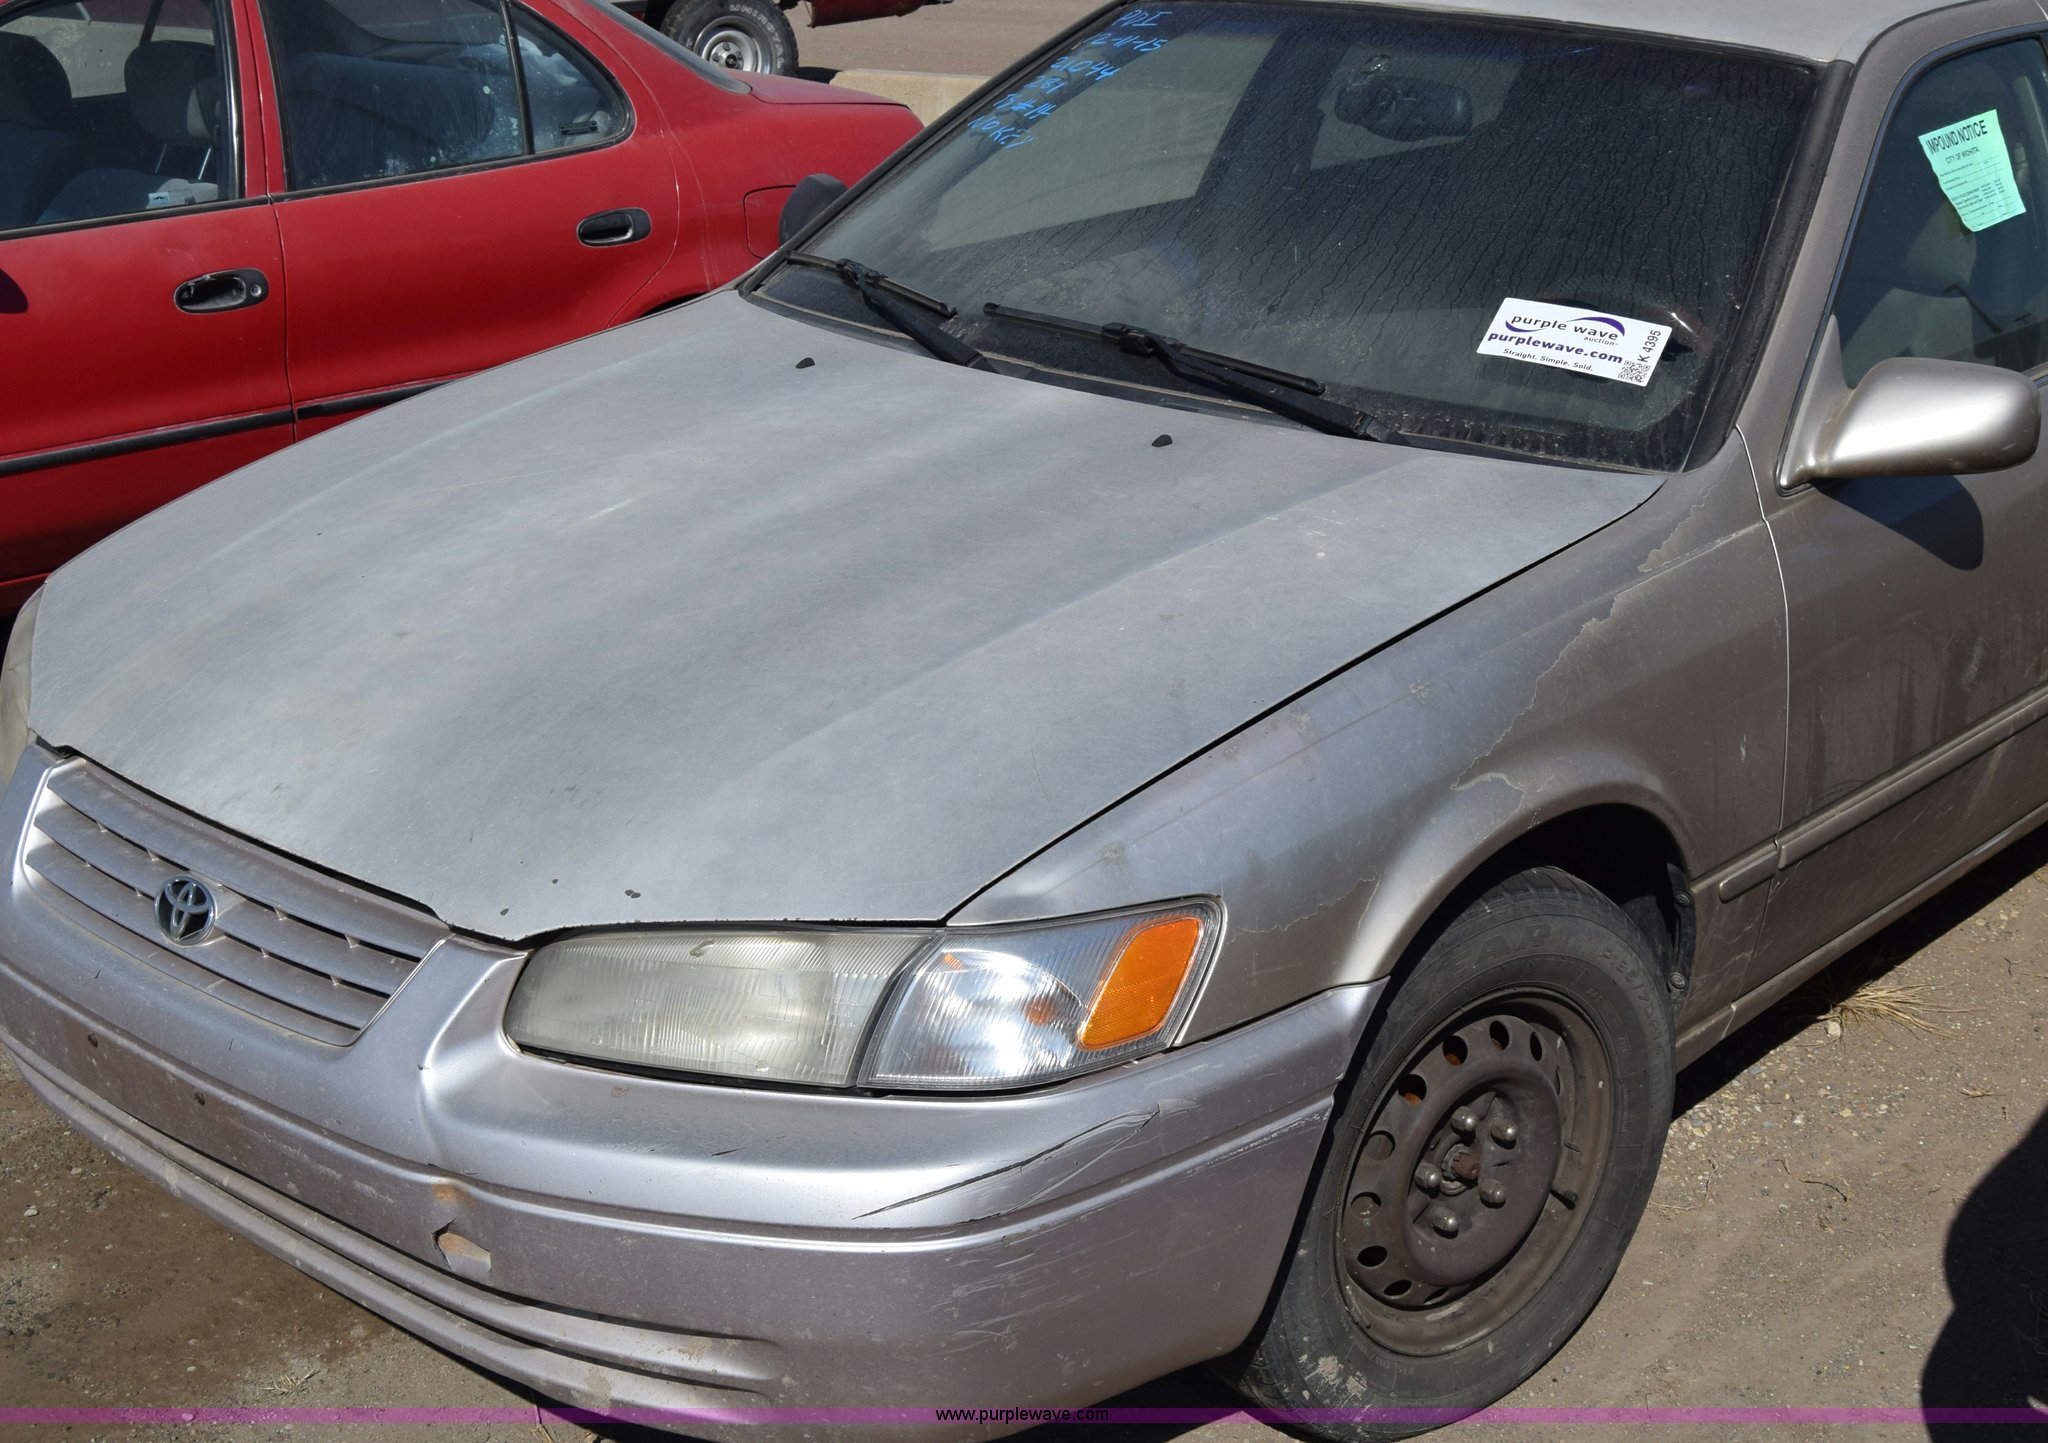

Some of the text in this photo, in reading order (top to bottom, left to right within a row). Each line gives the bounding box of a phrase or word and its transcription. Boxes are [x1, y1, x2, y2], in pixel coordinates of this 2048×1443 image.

[1925, 119, 1988, 154] IMPOUND NOTICE
[1945, 156, 1955, 164] CITY
[1511, 315, 1619, 341] purple wave
[1487, 332, 1623, 364] purplewave.com
[1583, 336, 1616, 347] auction
[1637, 329, 1662, 363] K 4395
[1503, 348, 1594, 372] Straight. Simple. Sold.
